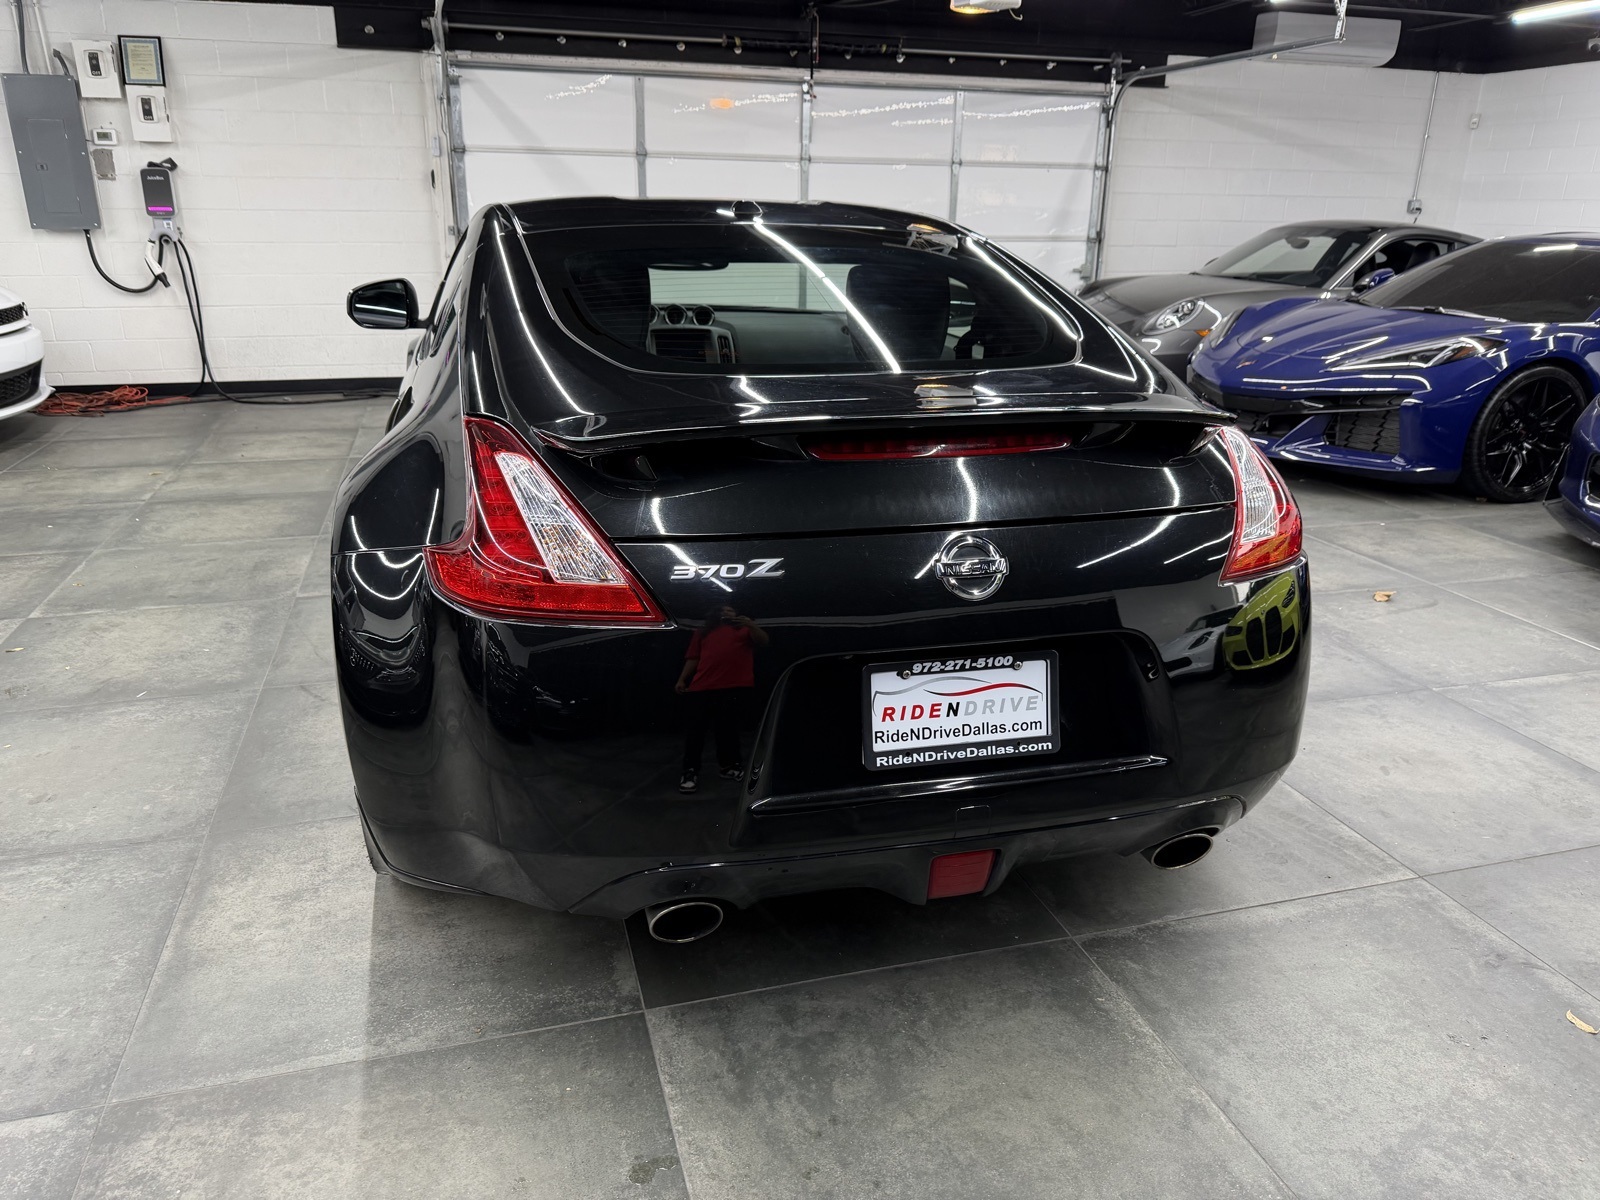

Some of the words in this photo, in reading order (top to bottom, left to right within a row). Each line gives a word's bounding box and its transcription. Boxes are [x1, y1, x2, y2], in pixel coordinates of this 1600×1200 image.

[945, 562, 999, 576] NISSAN
[912, 656, 1014, 674] 972-271-5100
[881, 695, 1039, 723] RIDENDRIVE
[874, 720, 1043, 744] RideNDriveDallas.com
[876, 742, 1052, 767] RideNDriveDallas.com
